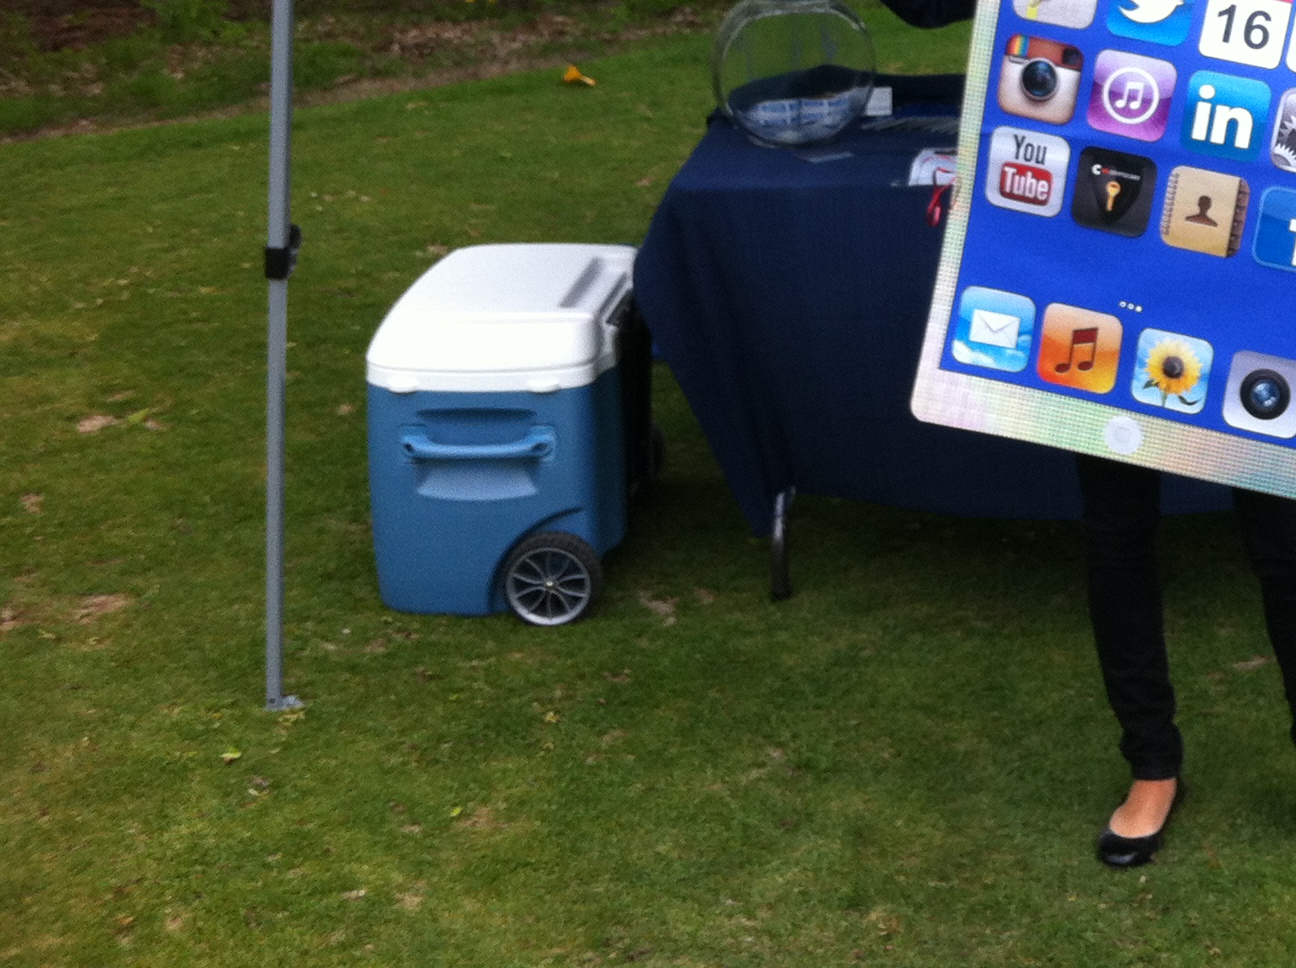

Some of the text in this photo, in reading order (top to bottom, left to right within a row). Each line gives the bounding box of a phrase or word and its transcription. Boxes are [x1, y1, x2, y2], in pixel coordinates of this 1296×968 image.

[1216, 3, 1272, 50] 16
[1191, 84, 1254, 149] in
[1013, 133, 1048, 166] You
[1001, 164, 1050, 202] Tube
